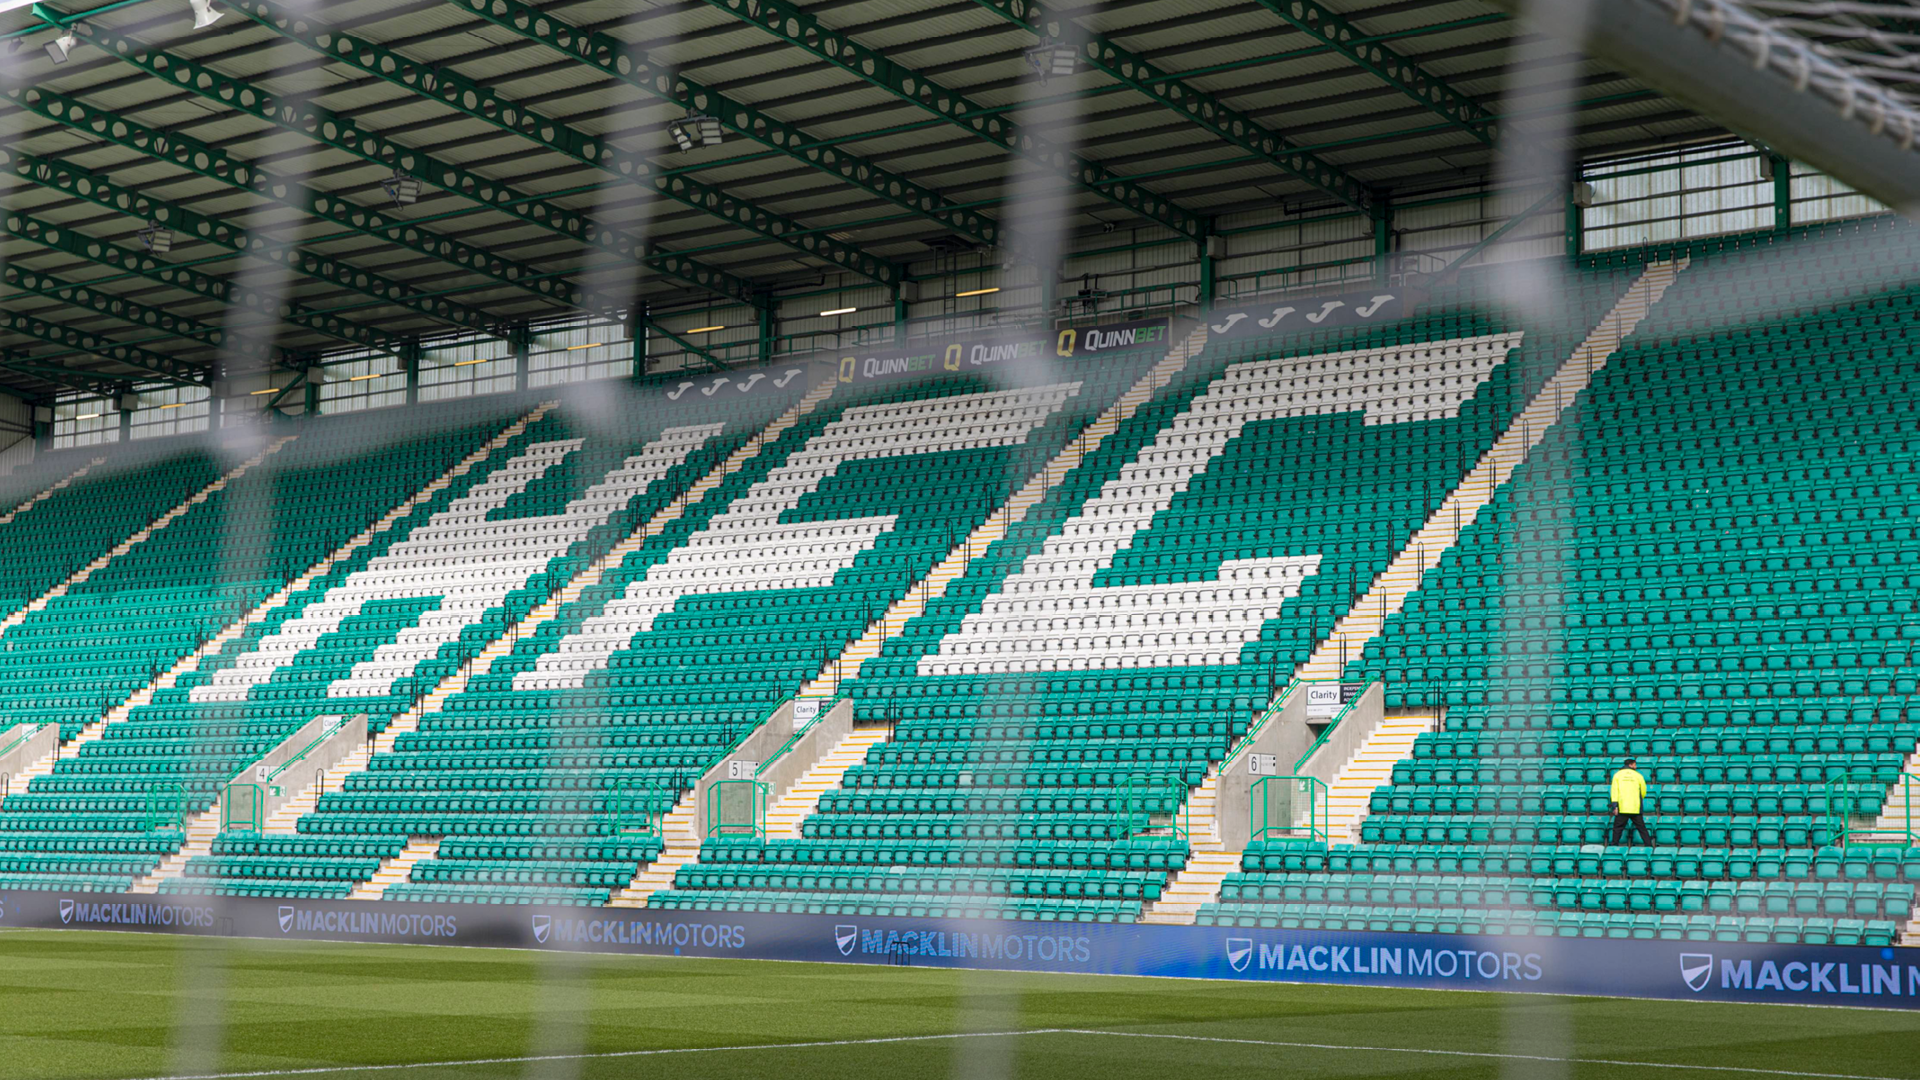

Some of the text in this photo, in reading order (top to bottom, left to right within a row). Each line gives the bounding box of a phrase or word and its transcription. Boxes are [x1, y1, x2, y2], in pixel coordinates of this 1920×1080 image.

[1310, 690, 1338, 701] Clarity
[796, 705, 817, 716] Clarity
[259, 768, 265, 780] 4
[732, 763, 738, 776] 5
[1251, 756, 1257, 772] 6
[75, 903, 214, 926] MACKLIN MOTORS
[296, 910, 457, 937] MACKLIN MOTORS
[554, 919, 745, 948] MACKLIN MOTORS
[861, 929, 1091, 962] MACKLIN MOTORS
[1259, 943, 1543, 980] MACKLIN MOTORS
[1721, 959, 1901, 996] MACKLIN
